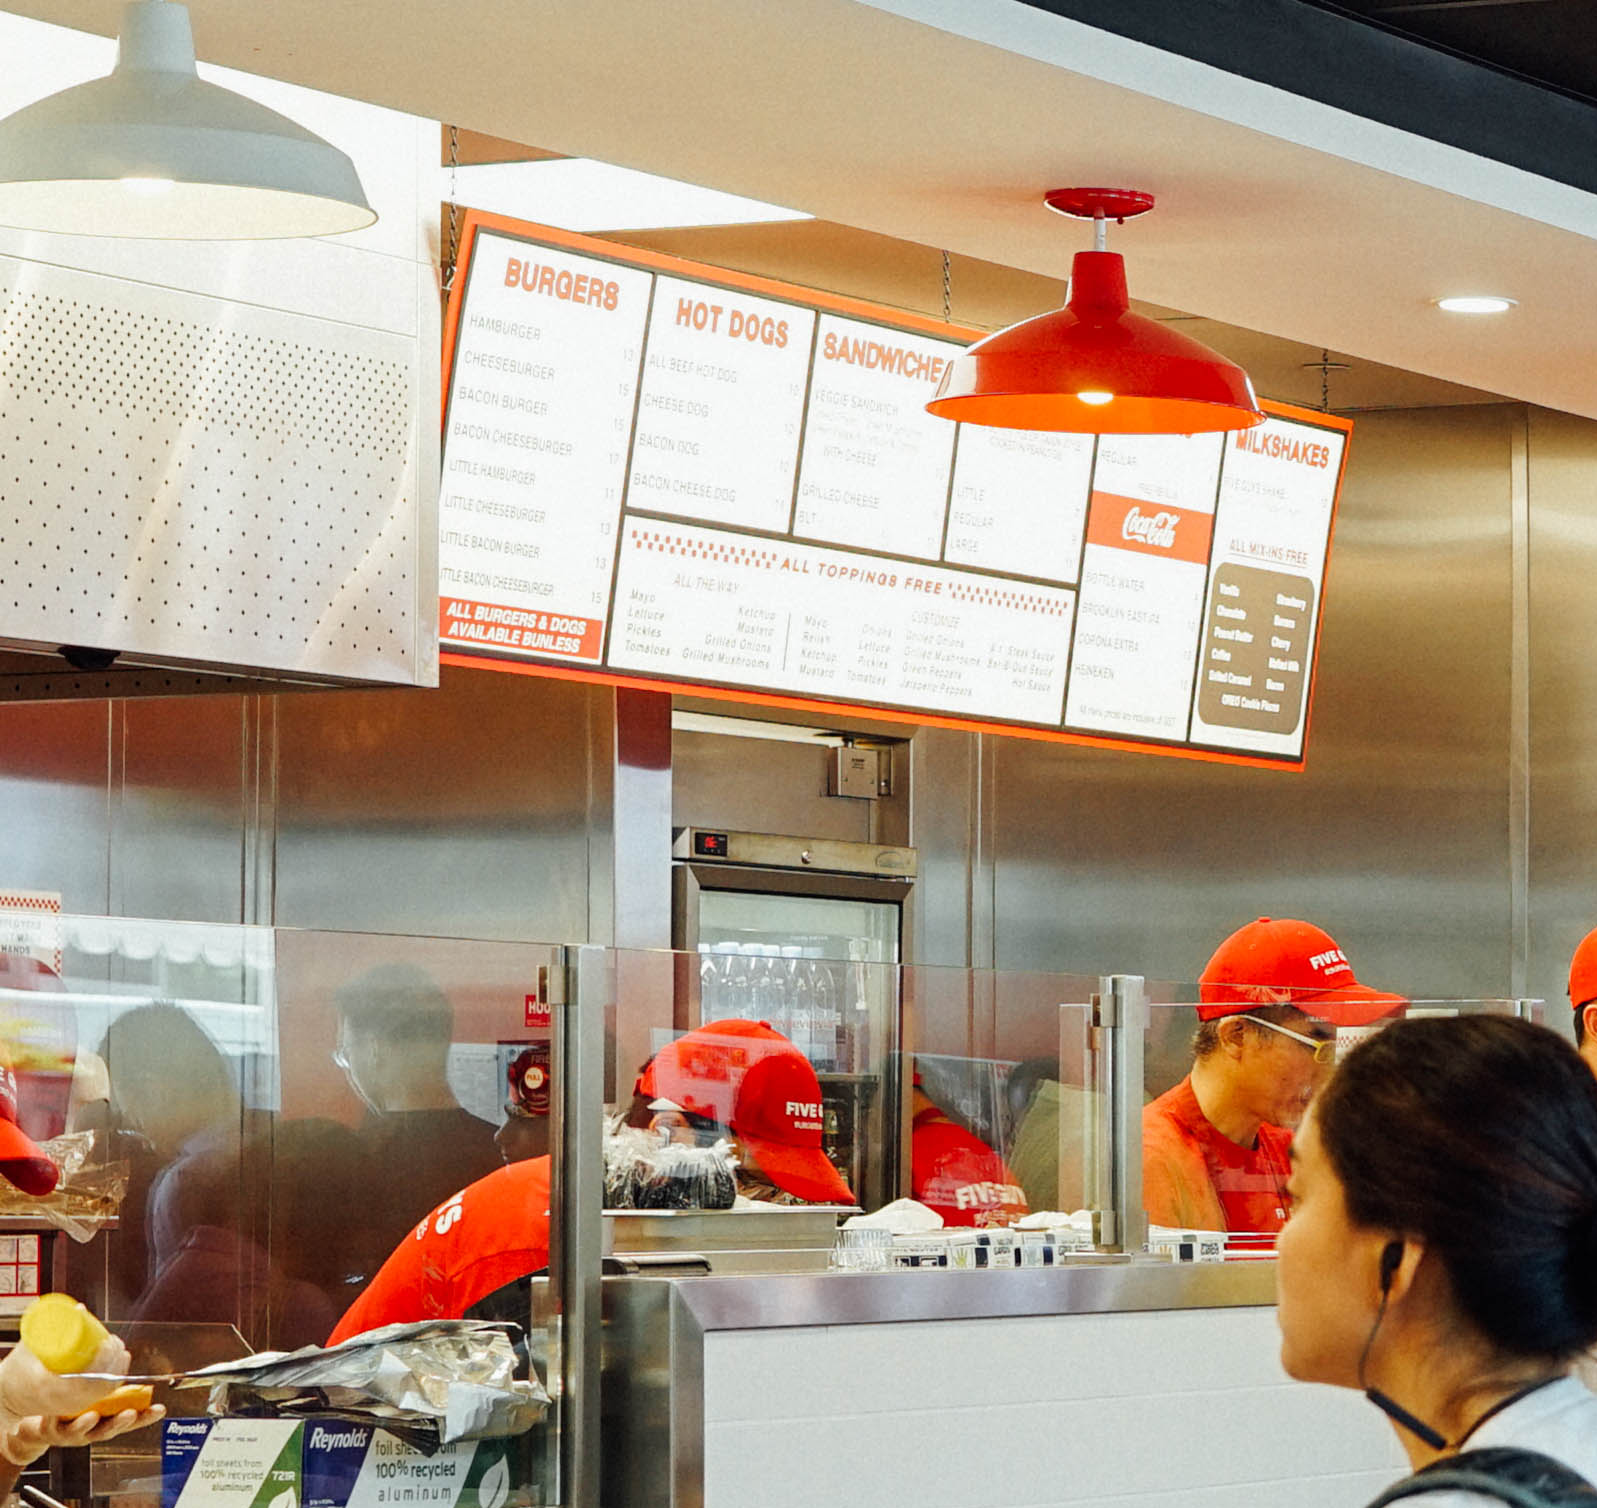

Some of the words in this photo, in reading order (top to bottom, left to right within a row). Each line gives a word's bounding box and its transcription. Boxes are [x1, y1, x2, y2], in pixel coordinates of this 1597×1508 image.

[504, 257, 620, 311] BURGERS
[470, 316, 541, 341] HAMBURGER
[675, 297, 723, 333] HOT
[728, 309, 789, 349] DOGS
[464, 350, 555, 380] CHEESEBURGER
[823, 332, 943, 384] SANDWICHE
[458, 386, 499, 408] BACON
[502, 394, 548, 416] BURGER
[453, 422, 490, 442] BACON
[493, 429, 573, 457] CHEESEBURGER
[1235, 429, 1330, 470] MILKSHAKES
[449, 459, 478, 476] LITTLE
[480, 464, 536, 486] HAMBURGER
[445, 494, 473, 511] LITTLE
[476, 499, 545, 524] CHEESEBURGER
[440, 529, 469, 547] LITTLE
[471, 535, 502, 553] BACON
[504, 541, 541, 560] BURGER
[440, 567, 461, 584] ITTLE
[780, 557, 810, 574] ALL
[817, 561, 899, 588] TOPPINGS
[903, 576, 944, 595] FREE
[447, 602, 471, 619] ALL
[475, 606, 536, 629] BURGERS
[538, 614, 547, 629] &
[550, 618, 587, 636] DOGS
[448, 621, 520, 644] AVAILABLE
[522, 633, 581, 653] BUNLESS
[1309, 950, 1340, 971] FIVE
[786, 1101, 818, 1119] FIVE
[166, 1422, 208, 1437] Reynolds
[309, 1427, 368, 1453] Reynolds
[375, 1440, 393, 1456] foil
[199, 1471, 226, 1480] 100%
[375, 1459, 410, 1479] 100%
[410, 1461, 456, 1480] recycled
[378, 1485, 451, 1502] aluminum
